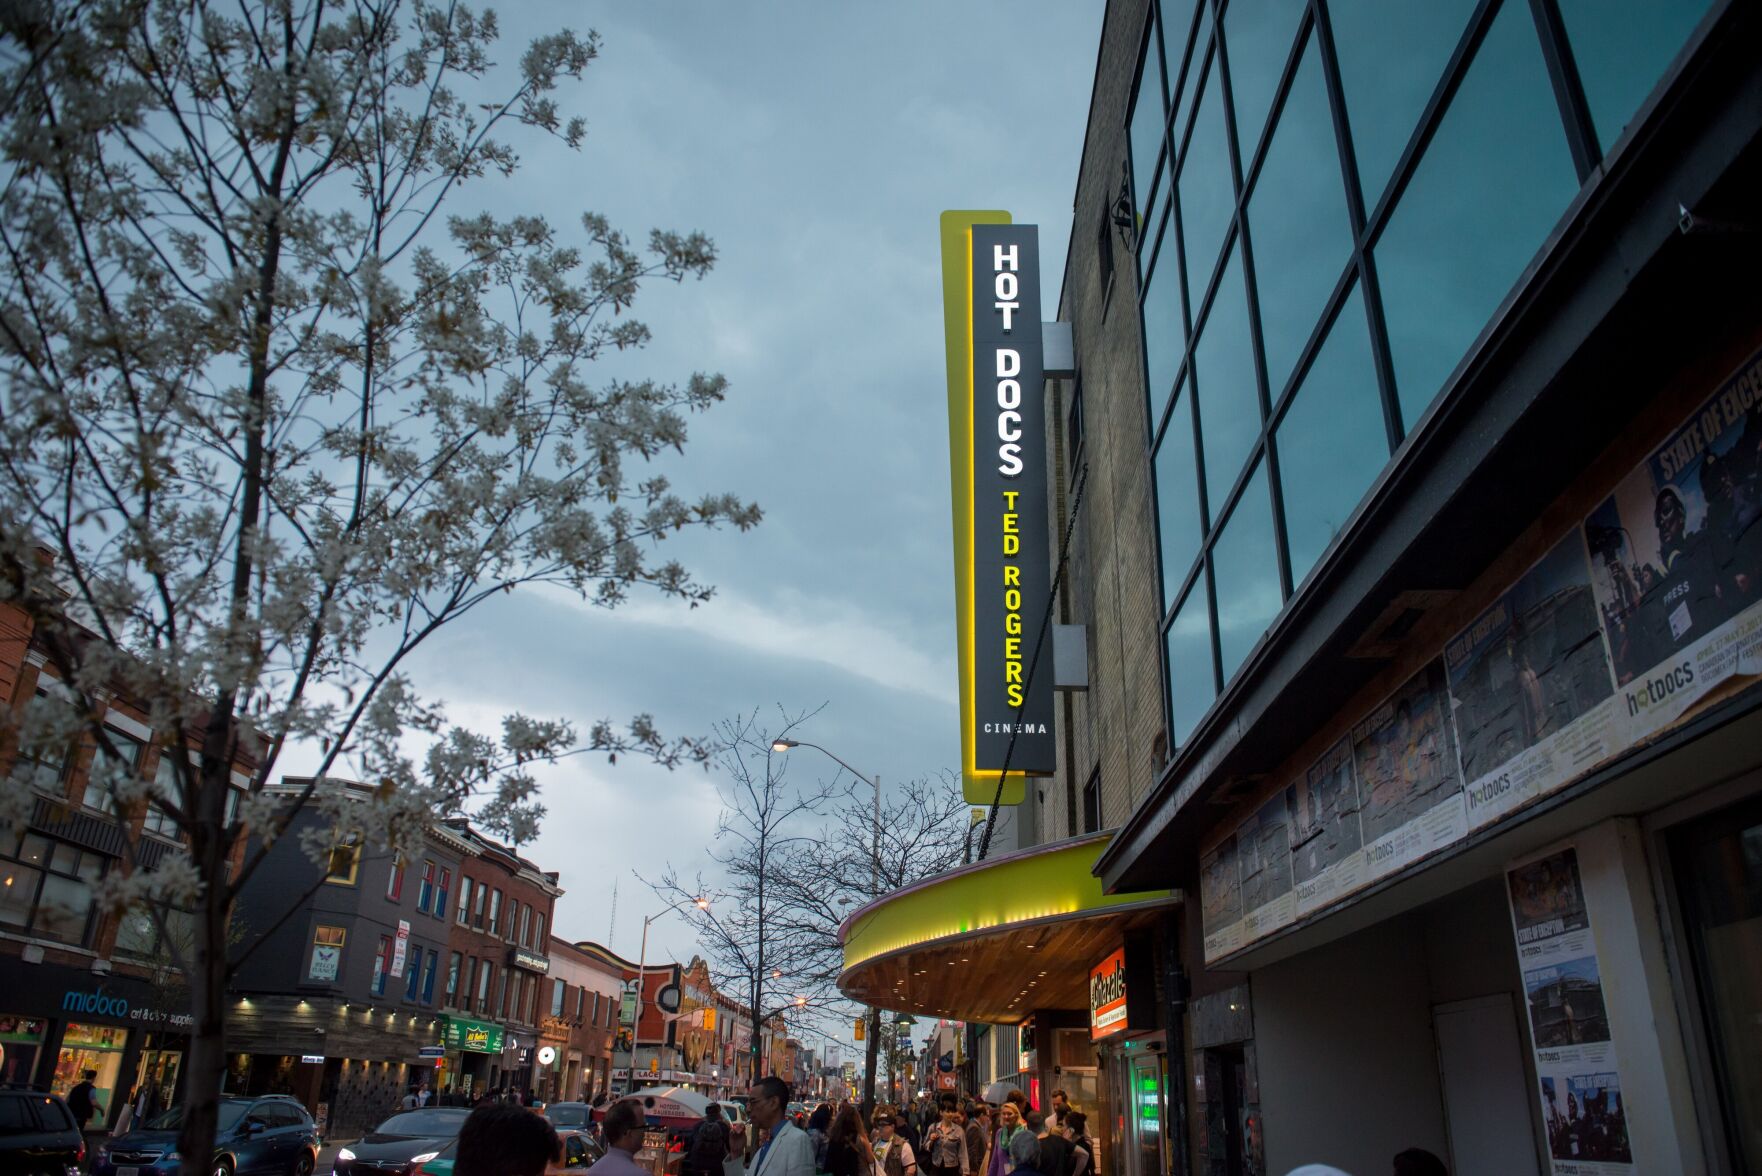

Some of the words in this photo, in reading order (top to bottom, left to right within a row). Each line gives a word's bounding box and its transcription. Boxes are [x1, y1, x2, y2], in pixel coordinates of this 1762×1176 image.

[993, 244, 1020, 332] HOT
[996, 347, 1024, 477] DOCS
[1659, 420, 1705, 481] STATE
[1700, 402, 1722, 443] OF
[1003, 491, 1020, 556] TED
[1004, 565, 1023, 708] ROGERS
[63, 988, 129, 1017] midoco
